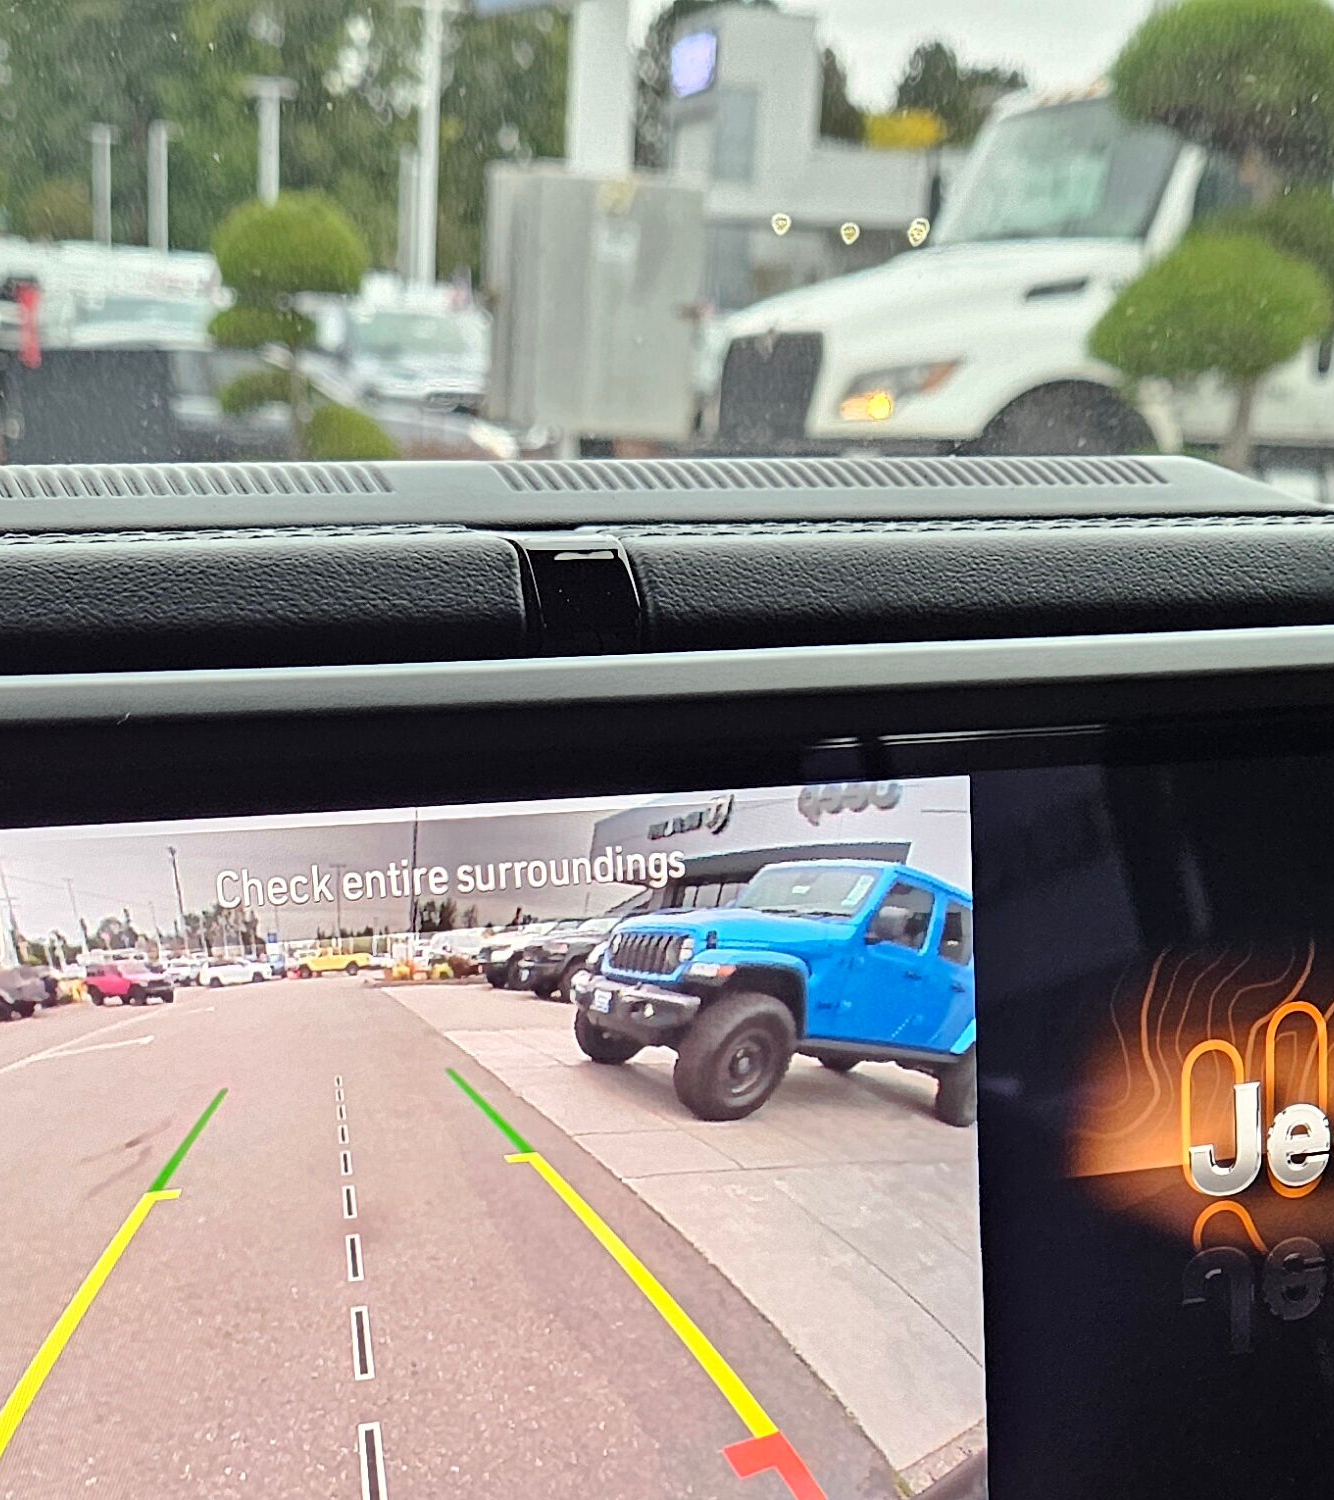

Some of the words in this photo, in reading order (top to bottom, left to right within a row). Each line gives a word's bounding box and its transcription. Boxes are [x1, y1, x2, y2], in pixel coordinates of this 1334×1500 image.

[215, 864, 334, 909] Check
[341, 858, 450, 901] entire
[456, 846, 687, 895] surroundings
